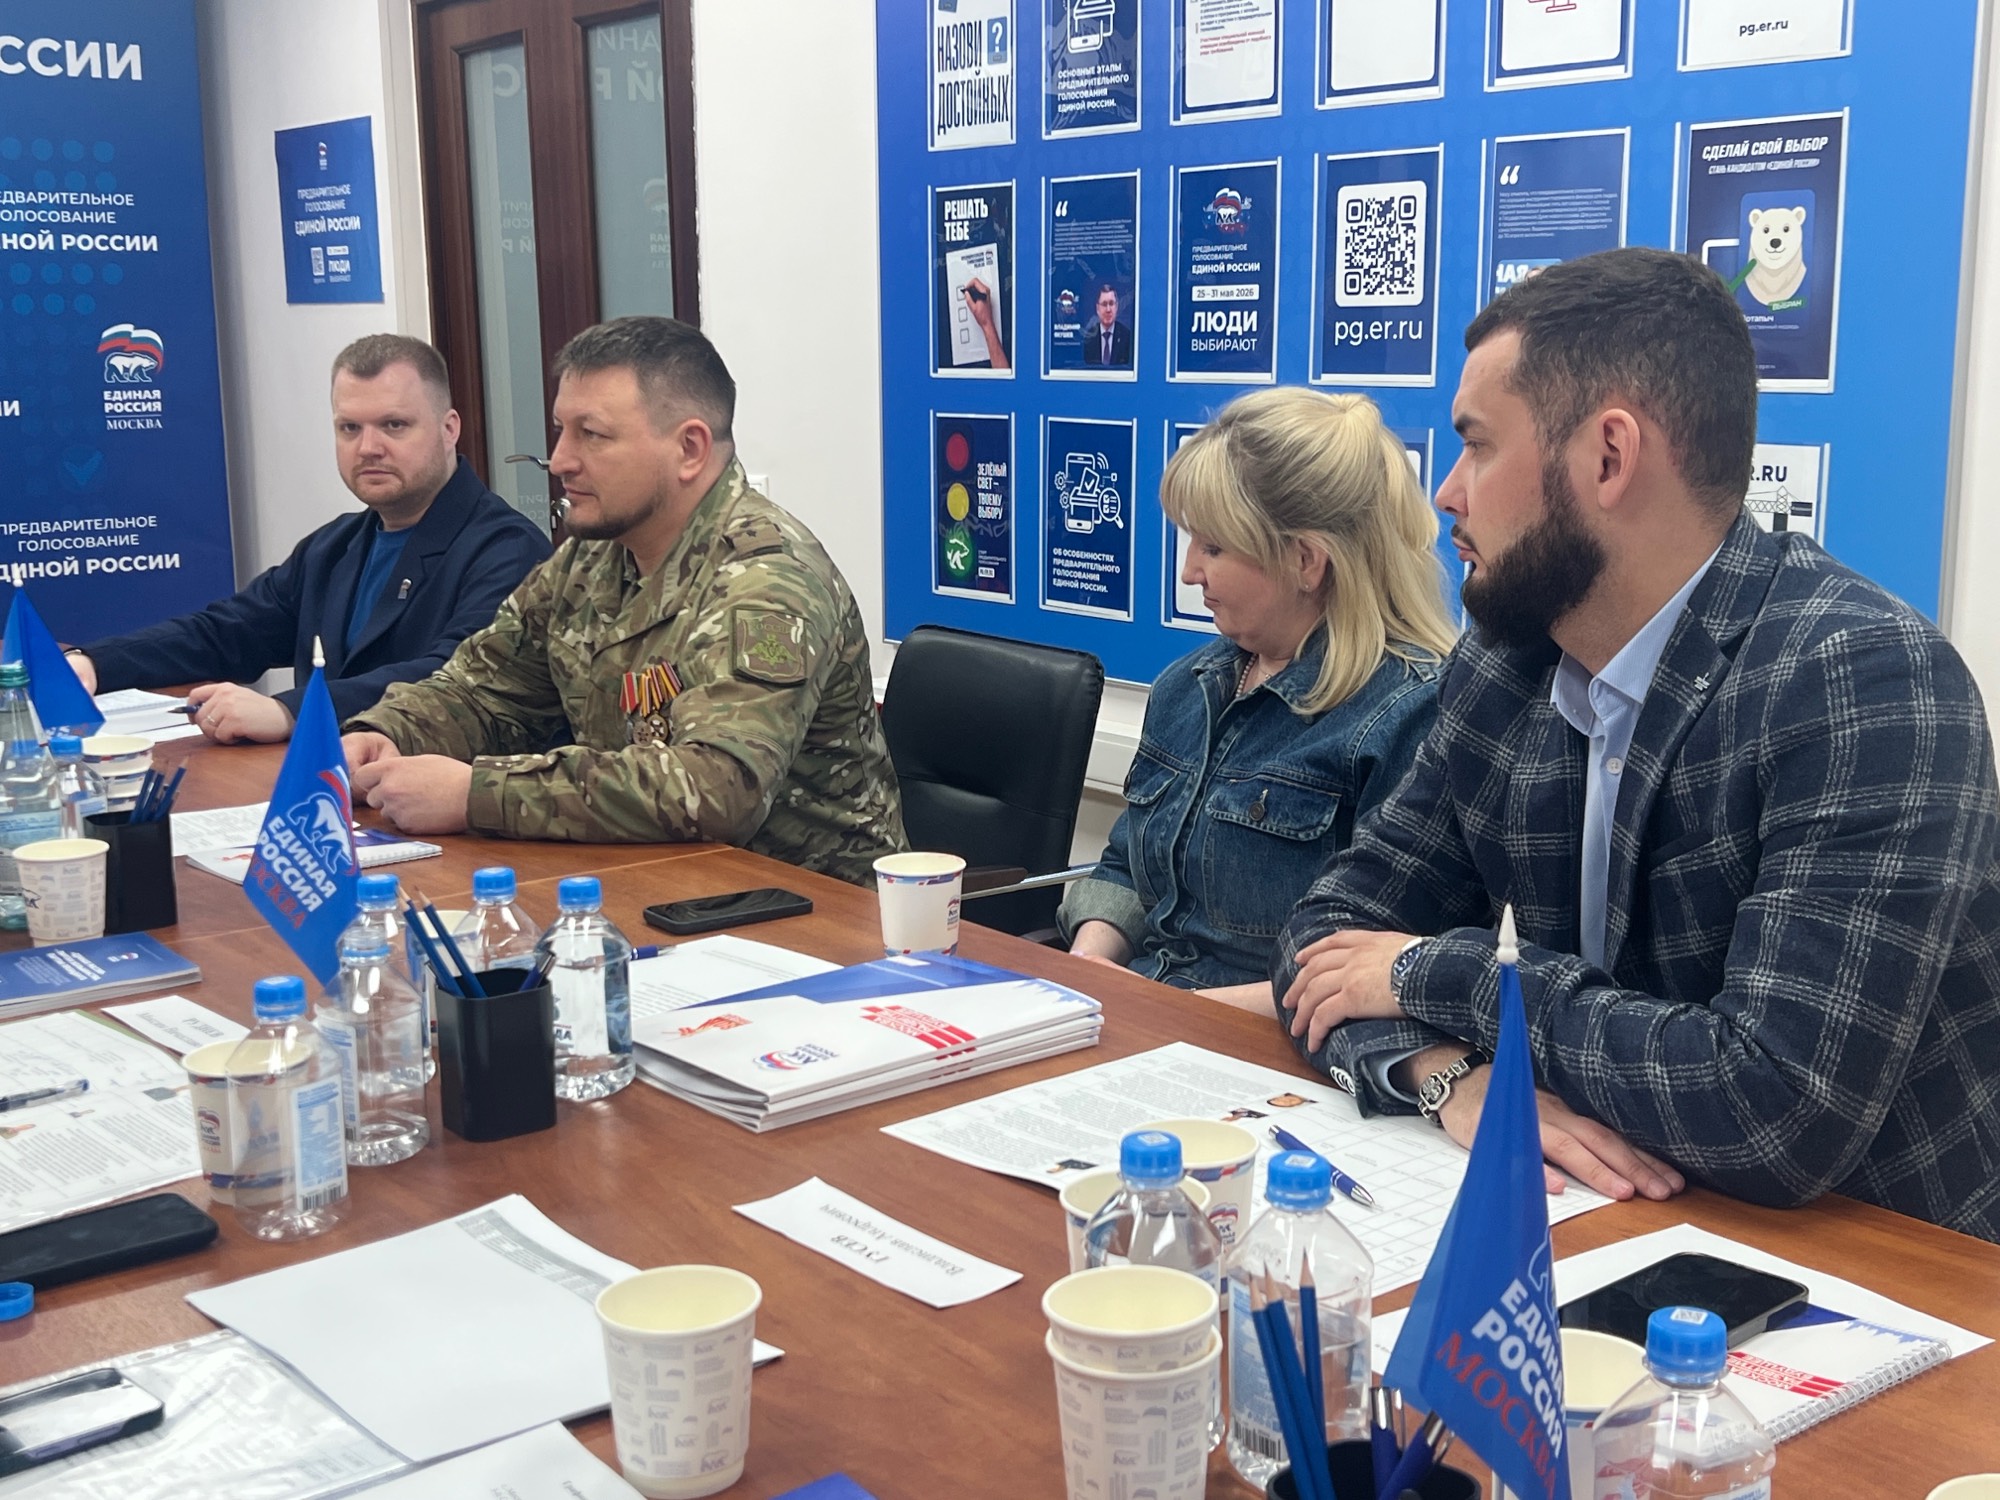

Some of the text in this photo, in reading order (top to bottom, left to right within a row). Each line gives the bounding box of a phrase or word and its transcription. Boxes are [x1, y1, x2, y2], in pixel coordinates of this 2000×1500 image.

[1739, 20, 1789, 37] pg.er.ru
[937, 20, 983, 73] НАЗОВИ
[1057, 63, 1122, 79] ОСНОВНЫЕ ЭТАПЫ
[1057, 74, 1130, 90] ПРЕДВАРИТЕЛЬНОГО
[937, 70, 1010, 136] ДОСТОЙНЫХ
[1057, 88, 1108, 102] ГОЛОСОВАНИЯ
[1057, 98, 1117, 113] ЕДИНОЙ РОССИИ.
[1702, 136, 1829, 161] СДЕЛАЙ СВОЙ ВЫБОР
[0, 190, 135, 207] ДВАРИТЕЛЬНОЕ
[944, 198, 988, 221] РЕШАТЬ
[294, 215, 361, 237] ЕДИНОЙ РОССИИ
[944, 220, 969, 242] ТЕБЕ
[0, 229, 158, 252] НОЙ РОССИИ
[1191, 261, 1261, 275] ЕДИНОЙ РОССИИ
[1220, 290, 1235, 299] мая
[1235, 287, 1255, 298] 2026
[1191, 310, 1258, 336] ЛЮДИ
[1334, 319, 1423, 346] pg.er.ru
[1191, 338, 1258, 352] ВЫБИРАЮТ
[103, 390, 161, 402] ЕДИНАЯ
[104, 401, 162, 413] РОССИЯ
[106, 419, 163, 430] МОСКВА
[977, 462, 1008, 477] ЗЕЛЁНЫЙ
[977, 476, 993, 490] СВЕТ
[977, 492, 1003, 507] ТВОЕМУ
[977, 505, 1004, 520] ВЫБОРУ
[0, 516, 157, 536] ПРЕДВАРИТЕЛЬНОЕ
[18, 534, 140, 553] ГОЛОСОВАНИЕ
[1052, 547, 1115, 563] ОБ ОСОБЕННОСТЯХ
[0, 553, 181, 584] ДИНОЙ РОССИИ
[1052, 558, 1120, 574] ПРЕДВАРИТЕЛЬНОГО
[1052, 568, 1100, 582] ГОЛОСОВАНИЯ
[1052, 578, 1080, 589] ЕДИНОЙ
[267, 815, 338, 899] ЕДИНАЯ
[257, 830, 324, 913] РОССИЯ
[1471, 1307, 1563, 1459] РОССИЯ
[1436, 1331, 1557, 1500] МОСКВА
